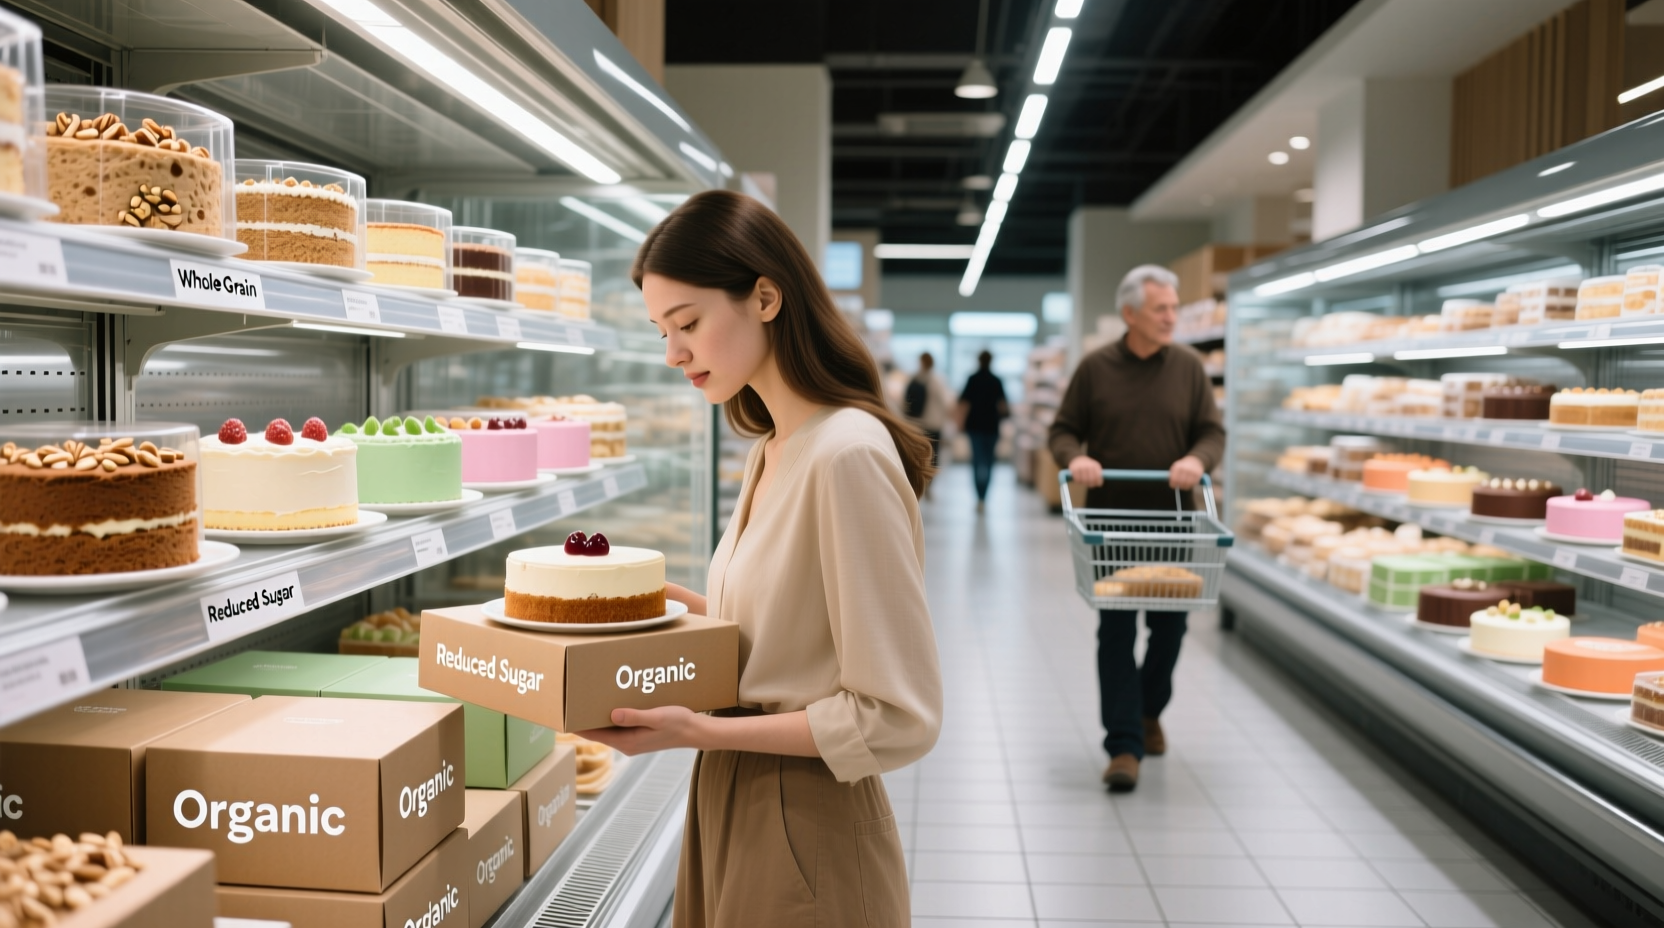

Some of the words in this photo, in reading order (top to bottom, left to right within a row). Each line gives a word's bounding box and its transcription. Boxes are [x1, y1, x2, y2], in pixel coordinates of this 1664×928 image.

[177, 268, 221, 291] Whole
[223, 275, 257, 298] Grain
[207, 598, 260, 623] Reduced
[261, 585, 294, 606] Sugar
[436, 642, 496, 679] Reduced
[499, 658, 544, 695] Sugar
[615, 657, 696, 693] Organic
[399, 760, 454, 819] Organic
[173, 789, 346, 844] Organic
[476, 835, 515, 885] Organic
